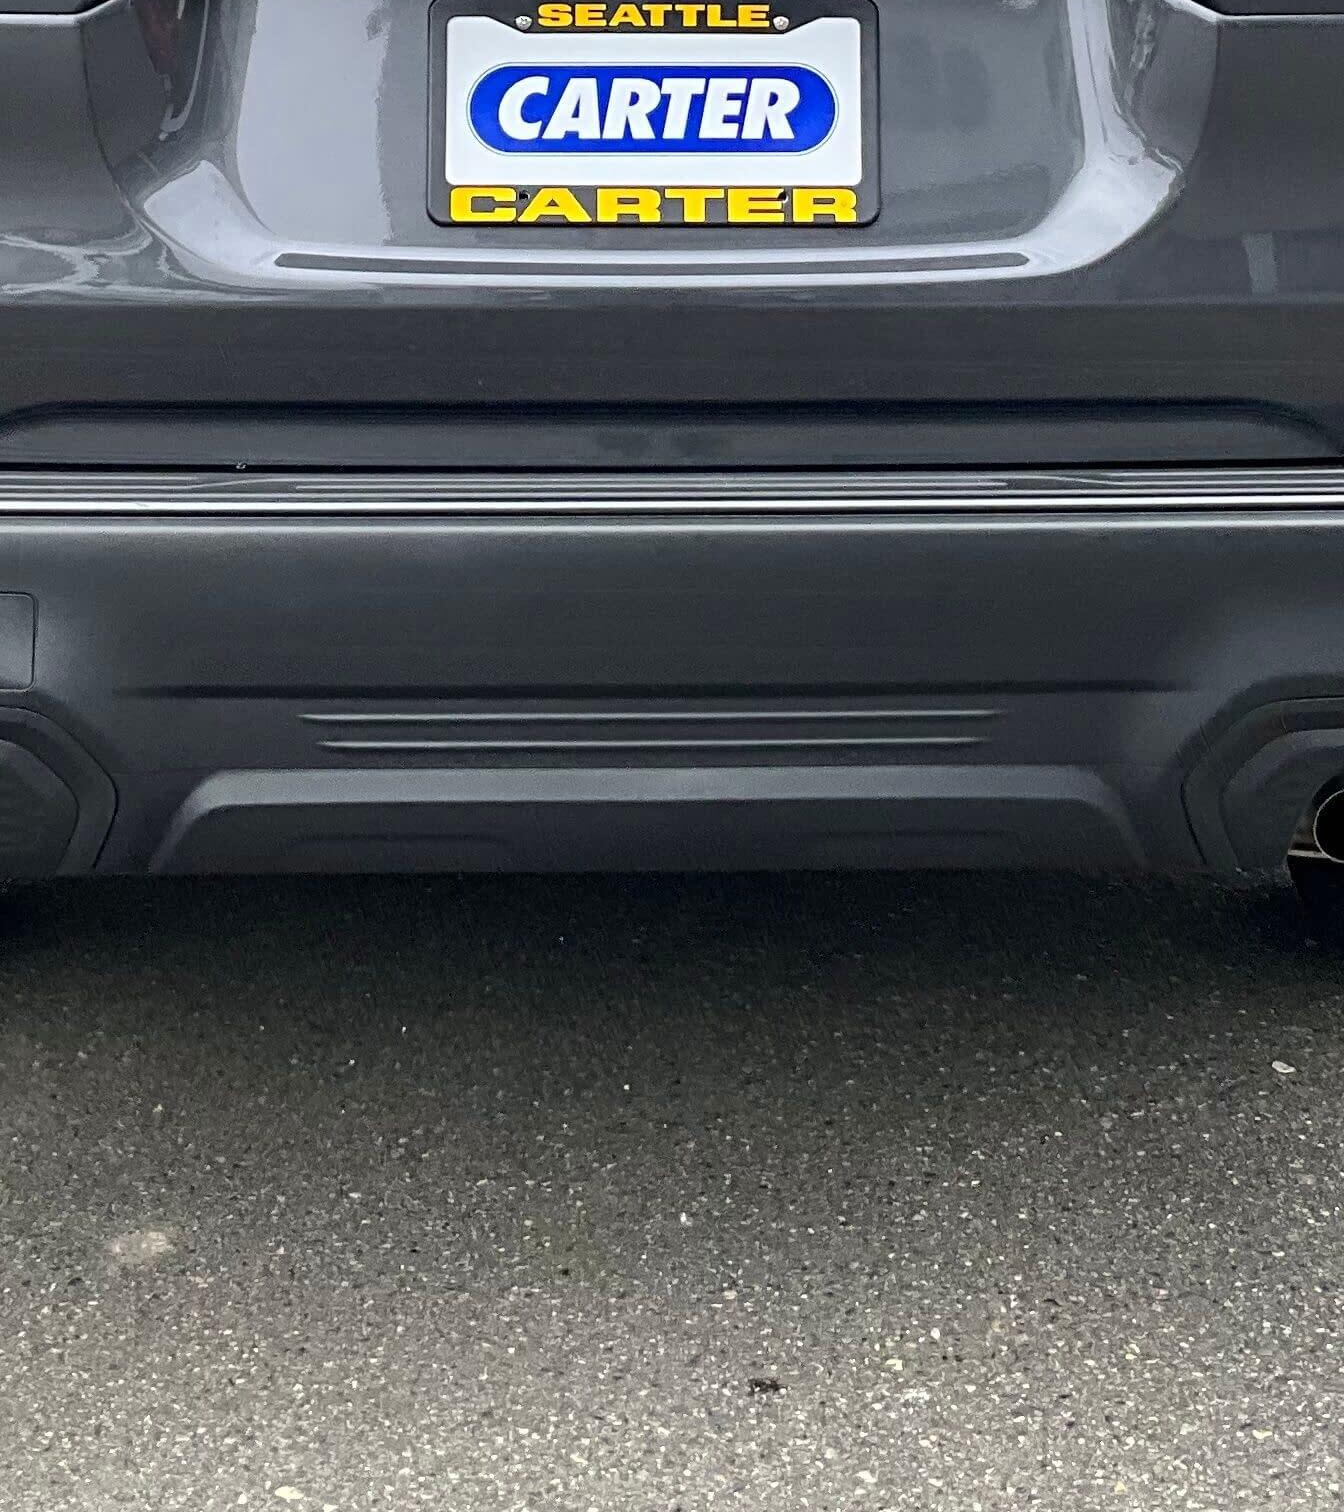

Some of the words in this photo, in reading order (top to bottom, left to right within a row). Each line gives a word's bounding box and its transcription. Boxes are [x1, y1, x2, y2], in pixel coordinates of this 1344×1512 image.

[537, 2, 771, 29] SEATTLE
[497, 75, 801, 141] CARTER
[449, 186, 858, 224] CARTER
